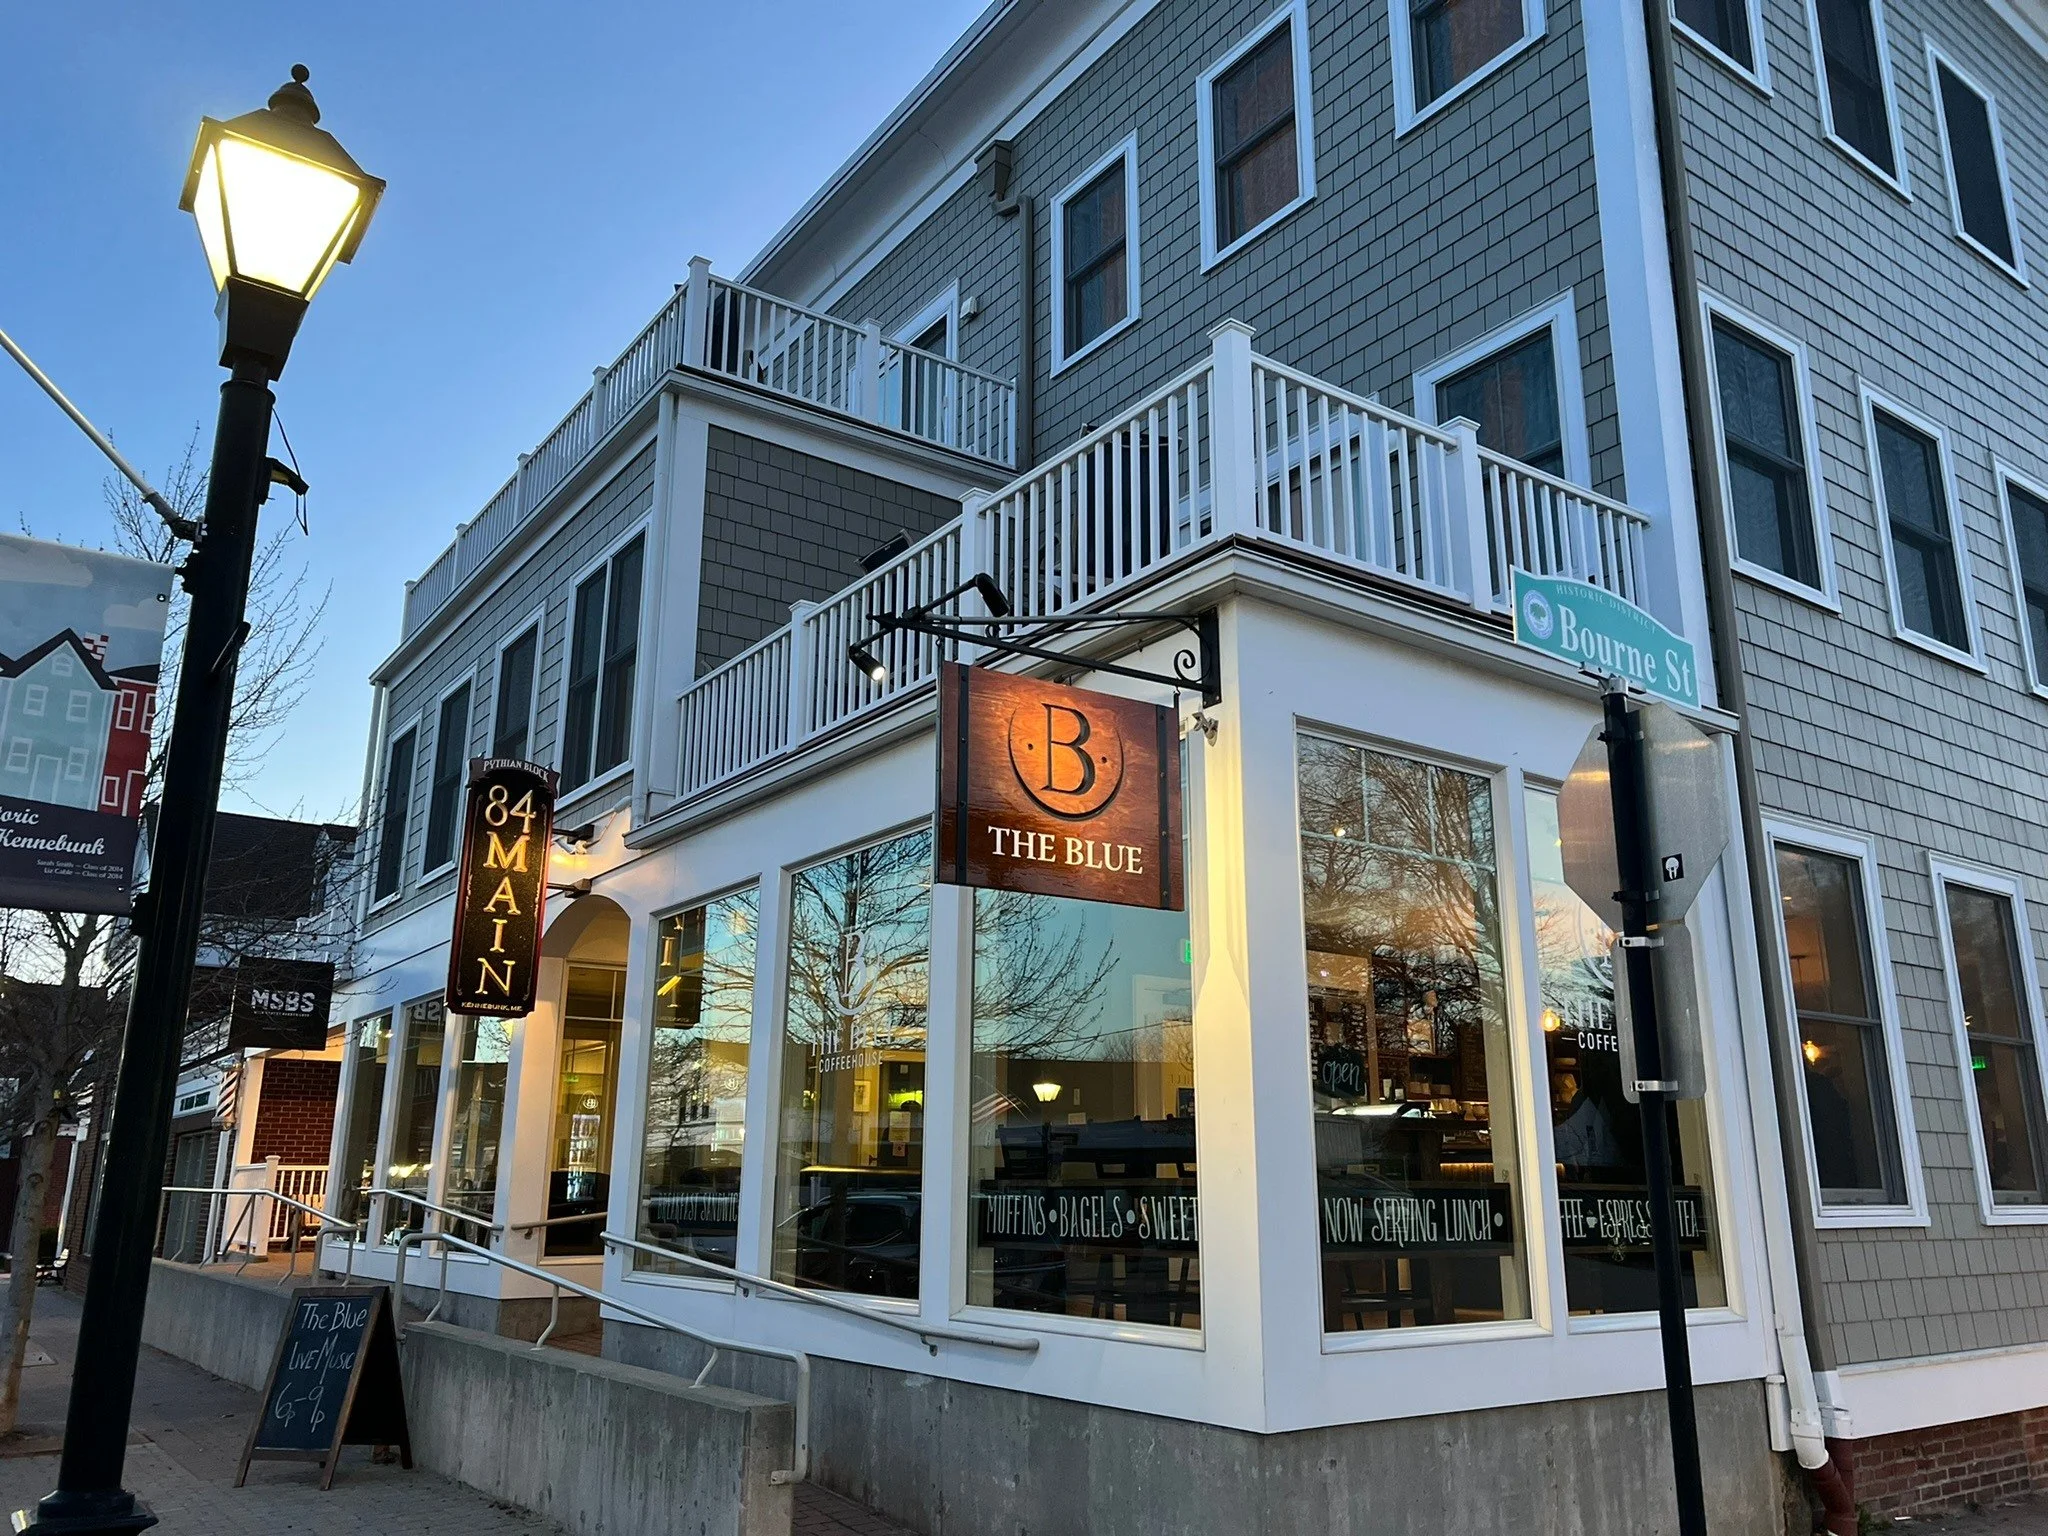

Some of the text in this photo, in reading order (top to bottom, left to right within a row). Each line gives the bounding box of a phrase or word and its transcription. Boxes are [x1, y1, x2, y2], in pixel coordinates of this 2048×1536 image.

[1556, 584, 1657, 635] HISTORIC DISTRICT
[1557, 603, 1658, 684] Bourne
[1665, 649, 1693, 698] St
[1040, 702, 1096, 796] B
[483, 759, 549, 783] PYTHIAN BLOCK
[485, 784, 537, 834] 84
[0, 828, 105, 856] Kennebunk
[988, 825, 1144, 875] THE BLUE
[474, 831, 531, 997] MAIN
[251, 989, 316, 1013] MSBS
[818, 1050, 883, 1074] COFFEEHOUSE
[1578, 1031, 1619, 1052] COFFE
[1322, 1060, 1360, 1092] open
[986, 1194, 1046, 1236] MUFFINS
[1058, 1196, 1123, 1239] BAGELS
[1324, 1197, 1492, 1248] NOW SERVING LUNCH
[1675, 1200, 1700, 1238] TEA
[301, 1301, 368, 1333] The Blue
